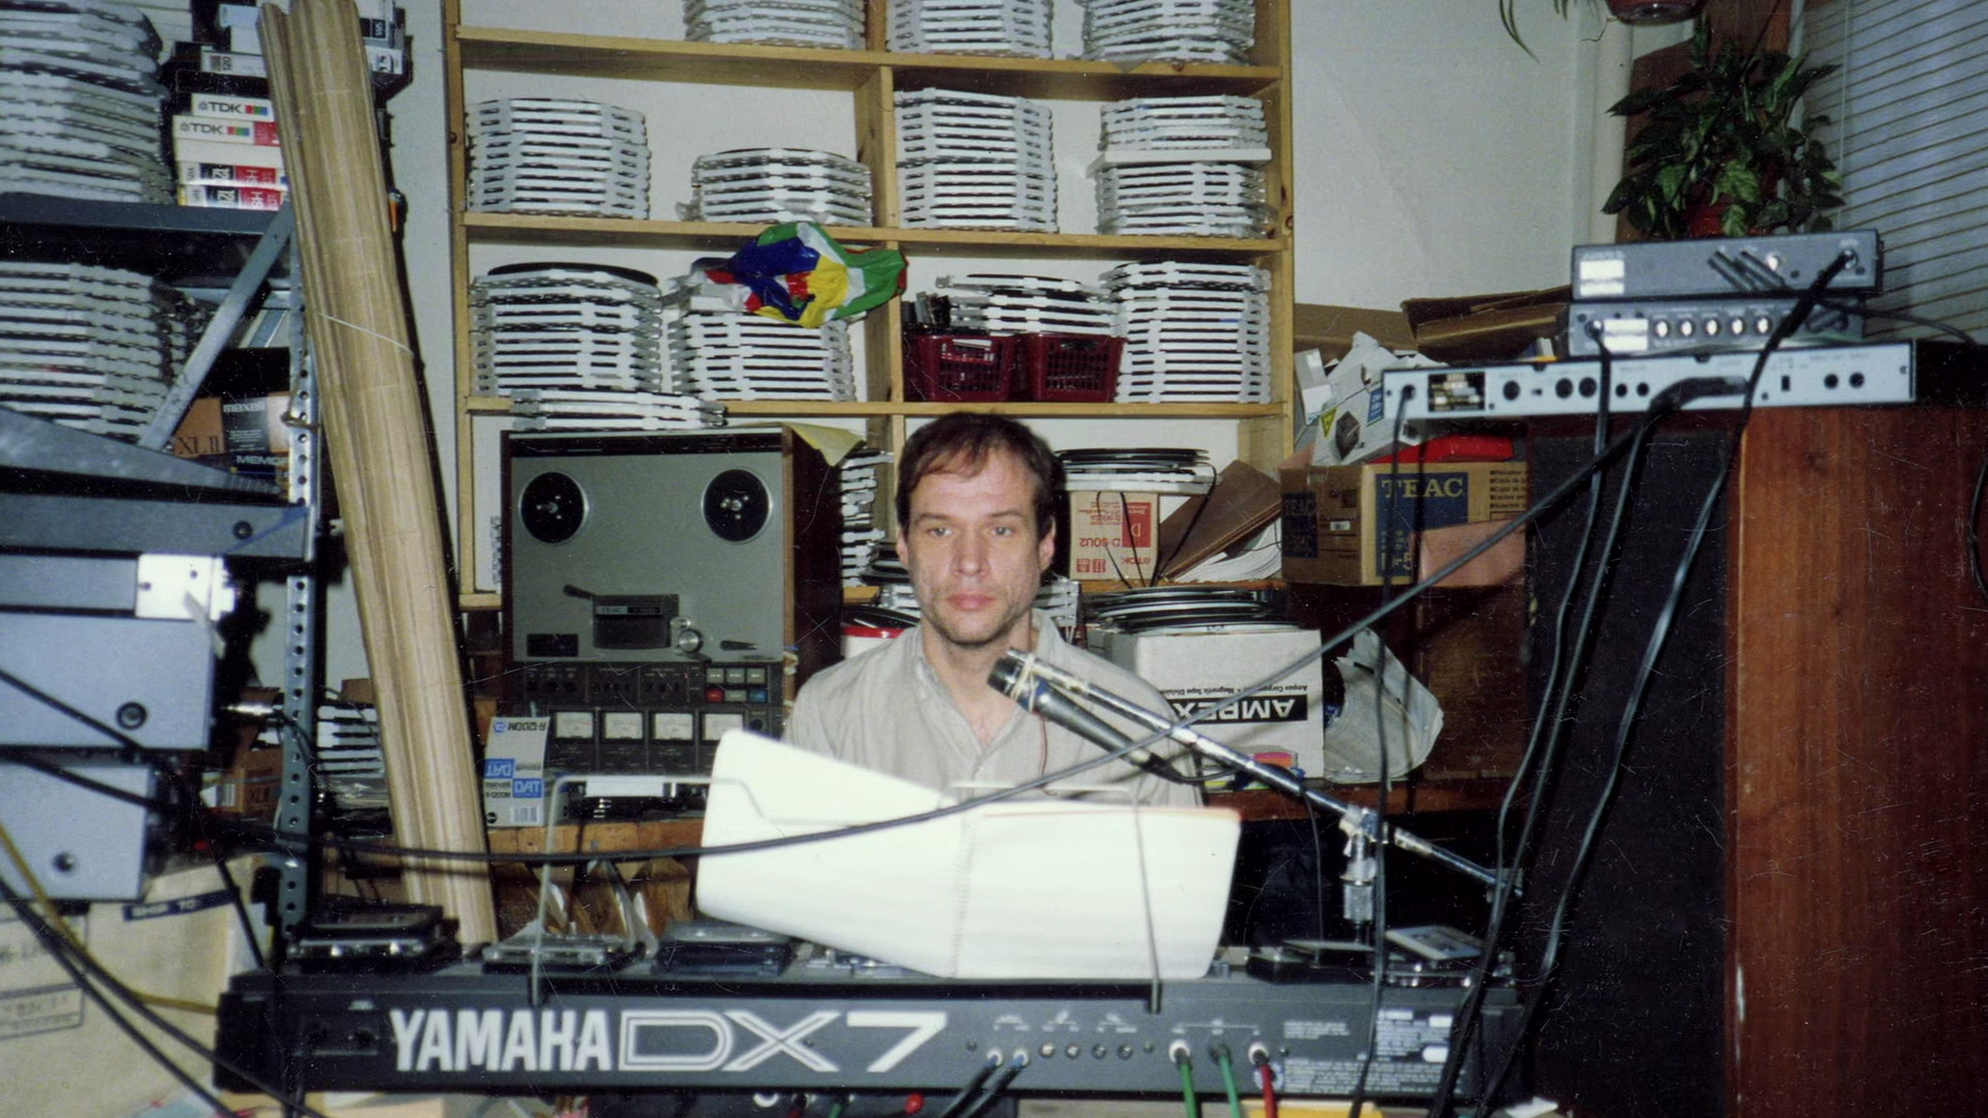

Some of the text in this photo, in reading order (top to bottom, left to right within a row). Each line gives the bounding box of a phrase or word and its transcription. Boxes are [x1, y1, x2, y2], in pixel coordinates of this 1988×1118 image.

[208, 101, 242, 114] TDK
[189, 122, 224, 135] TDK
[223, 401, 266, 413] maxell
[1381, 477, 1464, 499] TEAC
[484, 764, 513, 777] DAT
[513, 780, 541, 793] DAT
[390, 1009, 948, 1073] YAMAHA DX7
